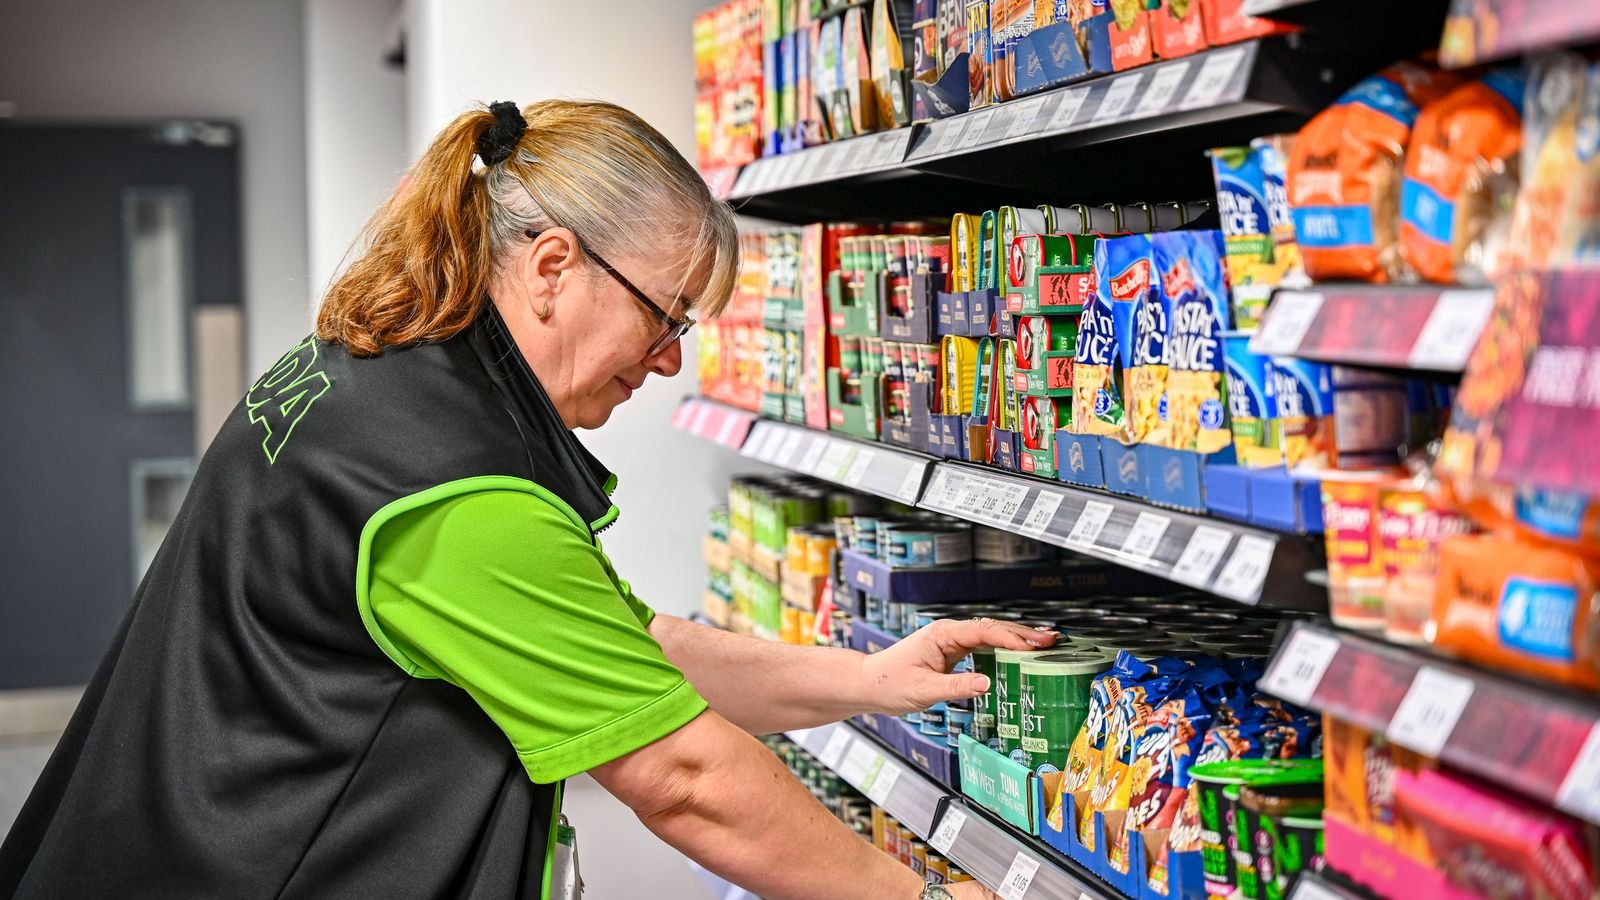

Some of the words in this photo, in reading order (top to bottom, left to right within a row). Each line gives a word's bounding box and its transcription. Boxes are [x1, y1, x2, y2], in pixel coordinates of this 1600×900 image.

[998, 702, 1017, 720] EST
[1023, 715, 1046, 733] EST
[1000, 771, 1021, 801] TUNA
